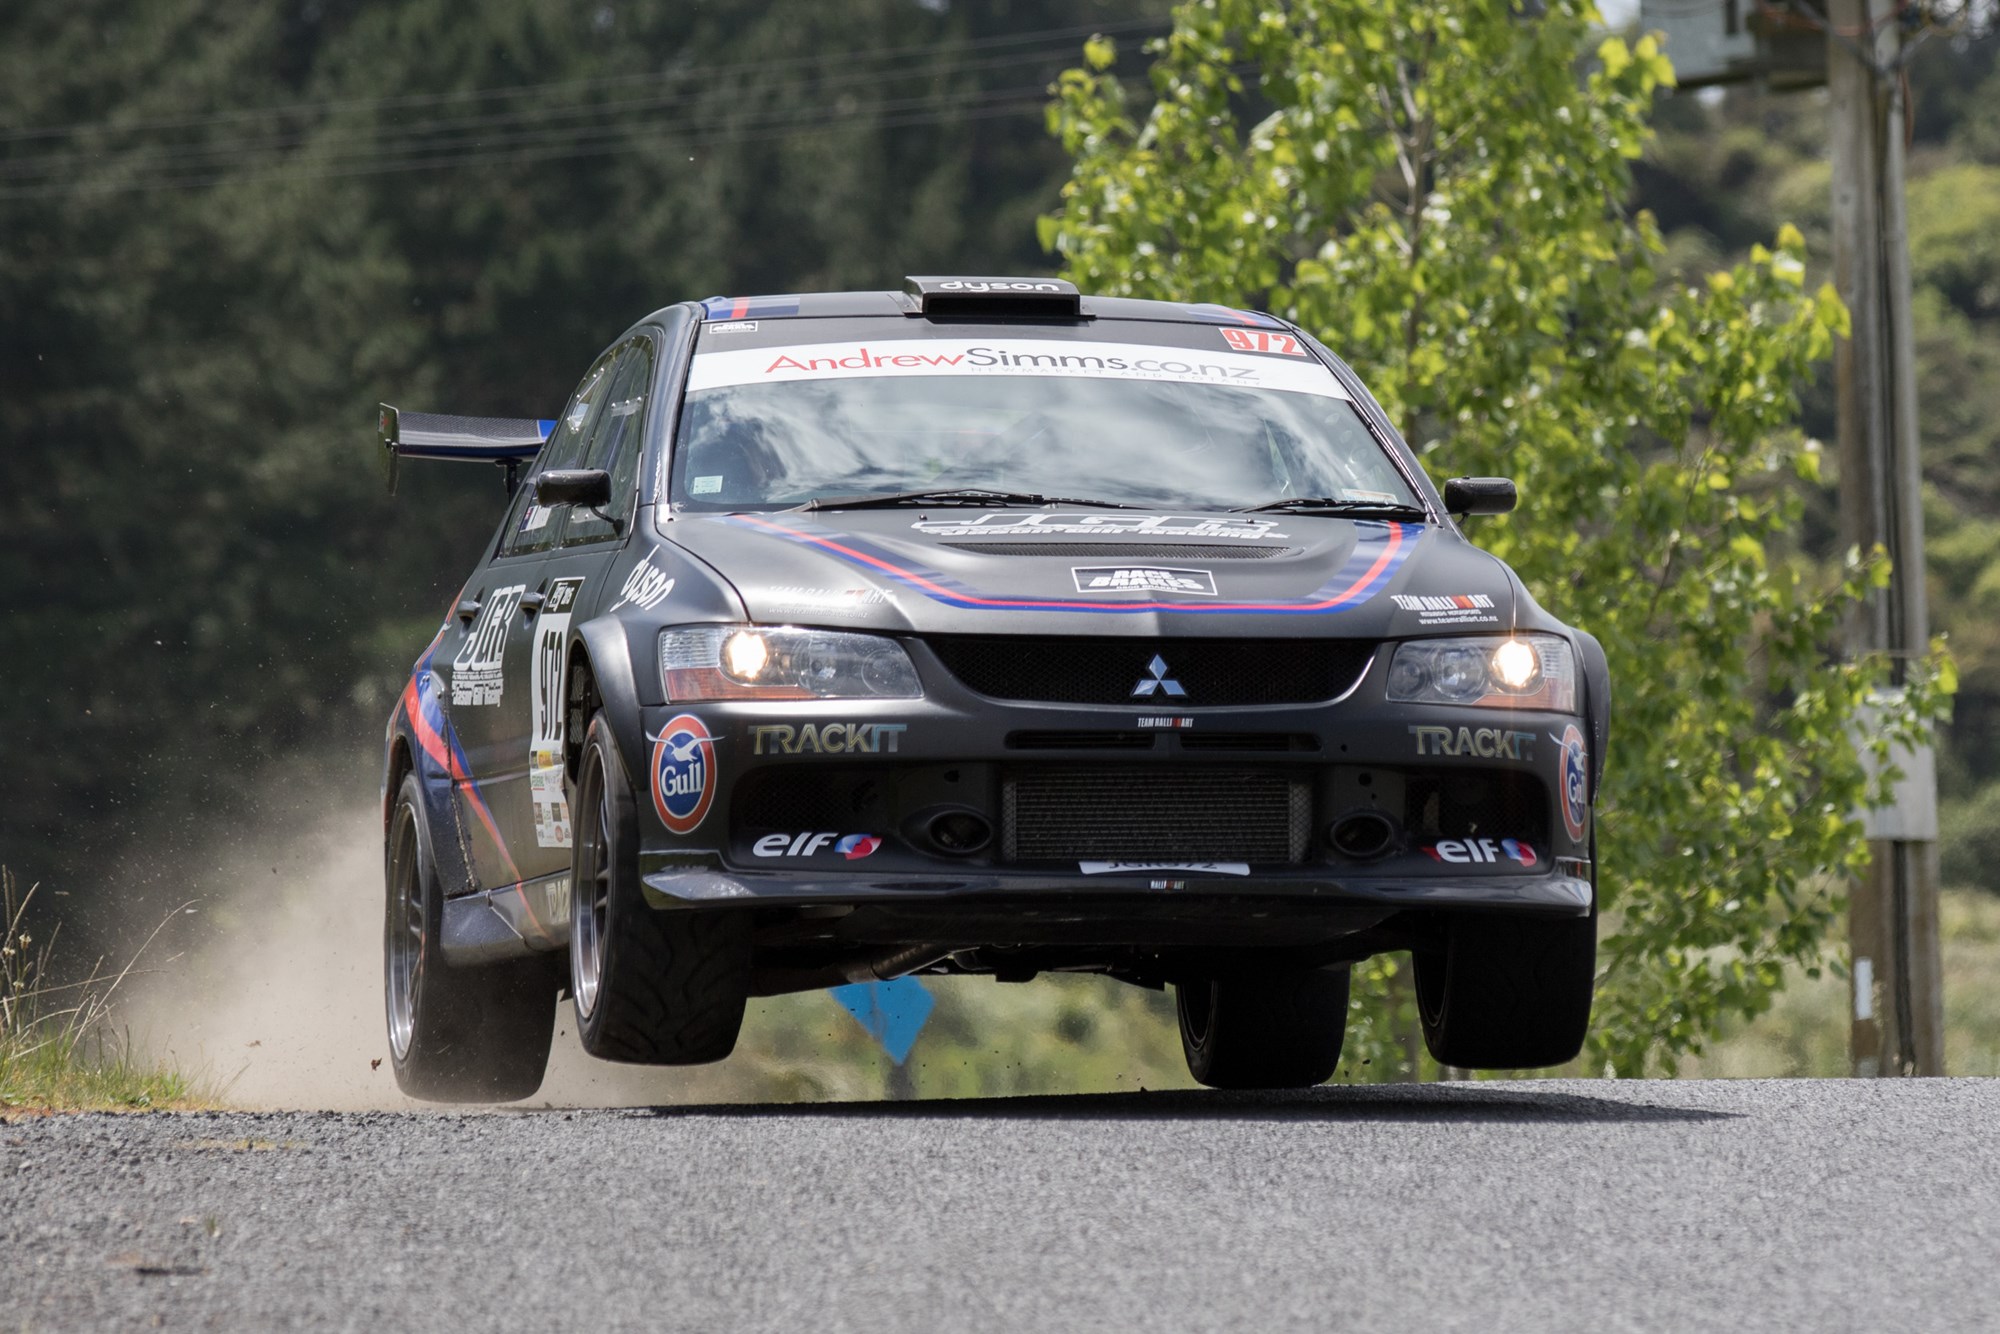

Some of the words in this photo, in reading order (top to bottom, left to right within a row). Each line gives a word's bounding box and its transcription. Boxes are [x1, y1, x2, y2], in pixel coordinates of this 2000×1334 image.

[939, 280, 1060, 292] dyson
[1221, 328, 1305, 356] 972
[765, 347, 1260, 381] AndrewSimms.co.nz
[609, 544, 675, 613] dyson
[1088, 576, 1205, 590] BRAKES
[1112, 569, 1176, 580] RACE
[1390, 594, 1426, 611] TEAM
[540, 629, 563, 741] 972
[1137, 717, 1155, 728] TEAM
[747, 723, 907, 755] TRACKIT
[1408, 725, 1537, 762] TRACKIT
[661, 761, 702, 797] Gull
[752, 832, 839, 857] elf
[1436, 838, 1500, 863] elf
